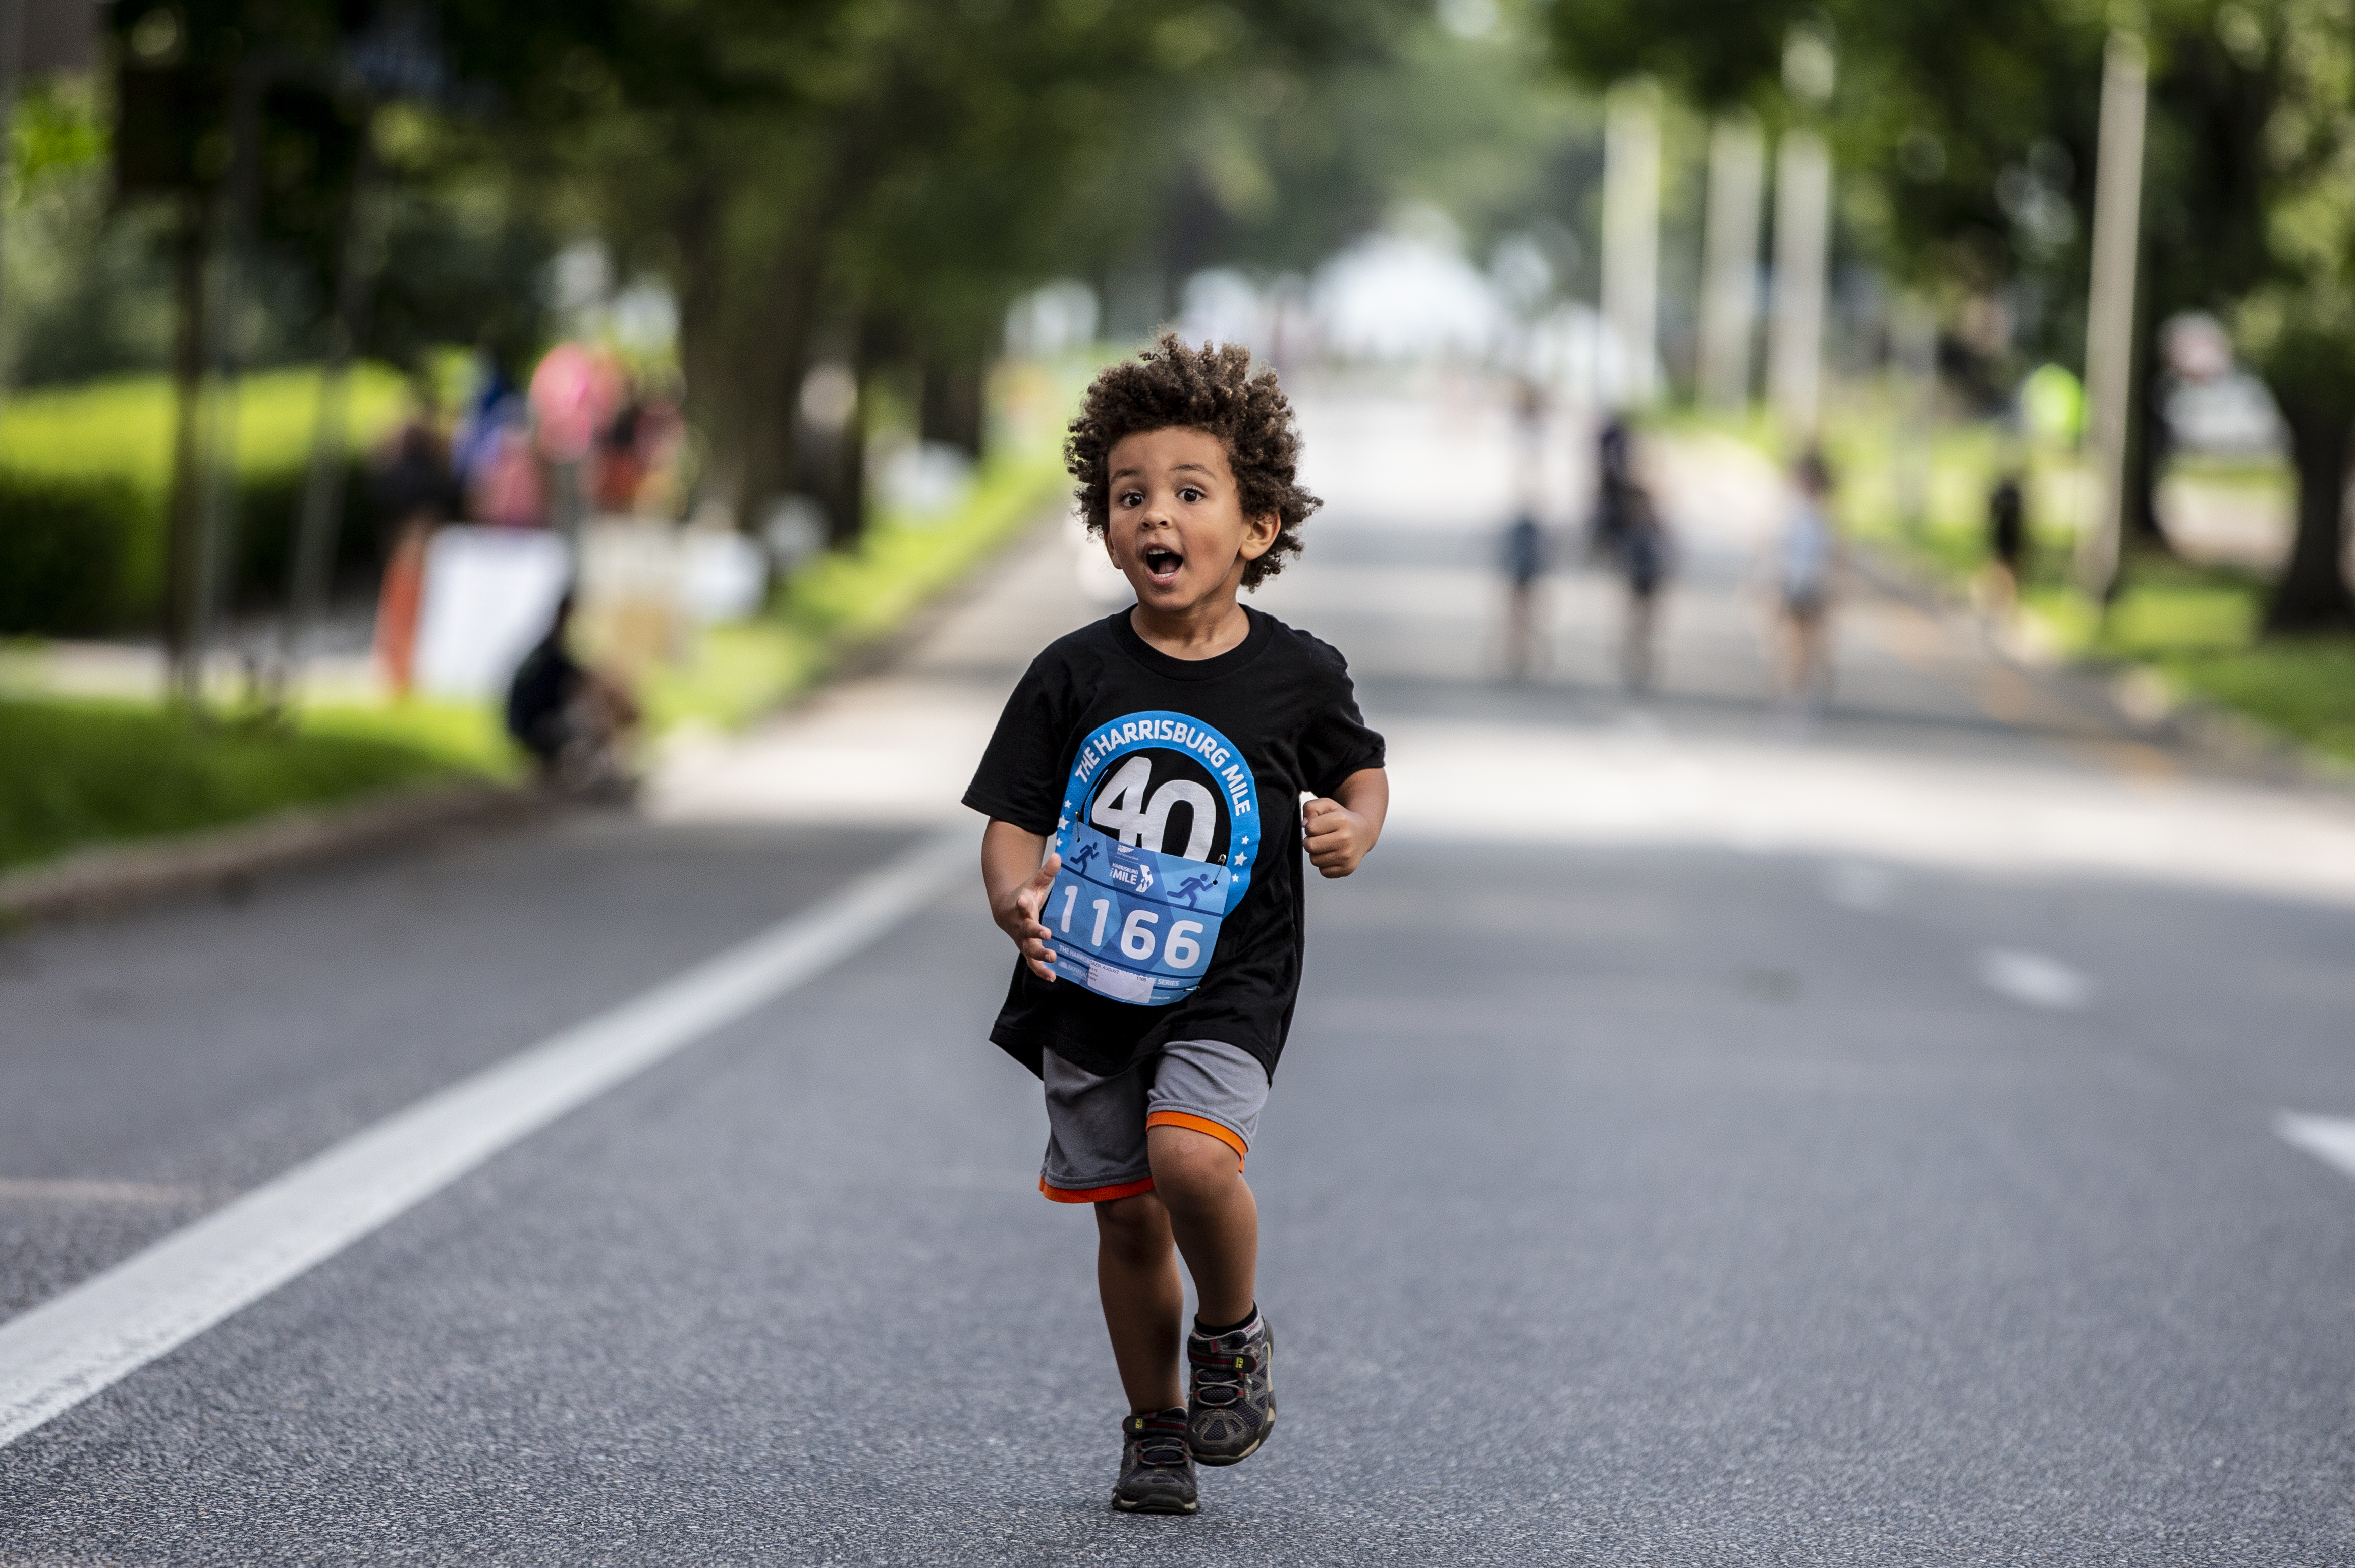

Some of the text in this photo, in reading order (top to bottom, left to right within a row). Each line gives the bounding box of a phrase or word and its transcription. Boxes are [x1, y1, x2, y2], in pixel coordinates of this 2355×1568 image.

[1075, 719, 1251, 817] THE HARRISBURG MILE
[1091, 756, 1216, 862] 40
[1112, 862, 1139, 875] HARRISBURG
[1113, 869, 1137, 885] MILE
[1061, 885, 1203, 969] 1166
[1059, 945, 1070, 955] THE
[1070, 950, 1090, 964] HARRISB
[1067, 964, 1089, 978] DONEGAL
[1103, 966, 1120, 974] AUGUST
